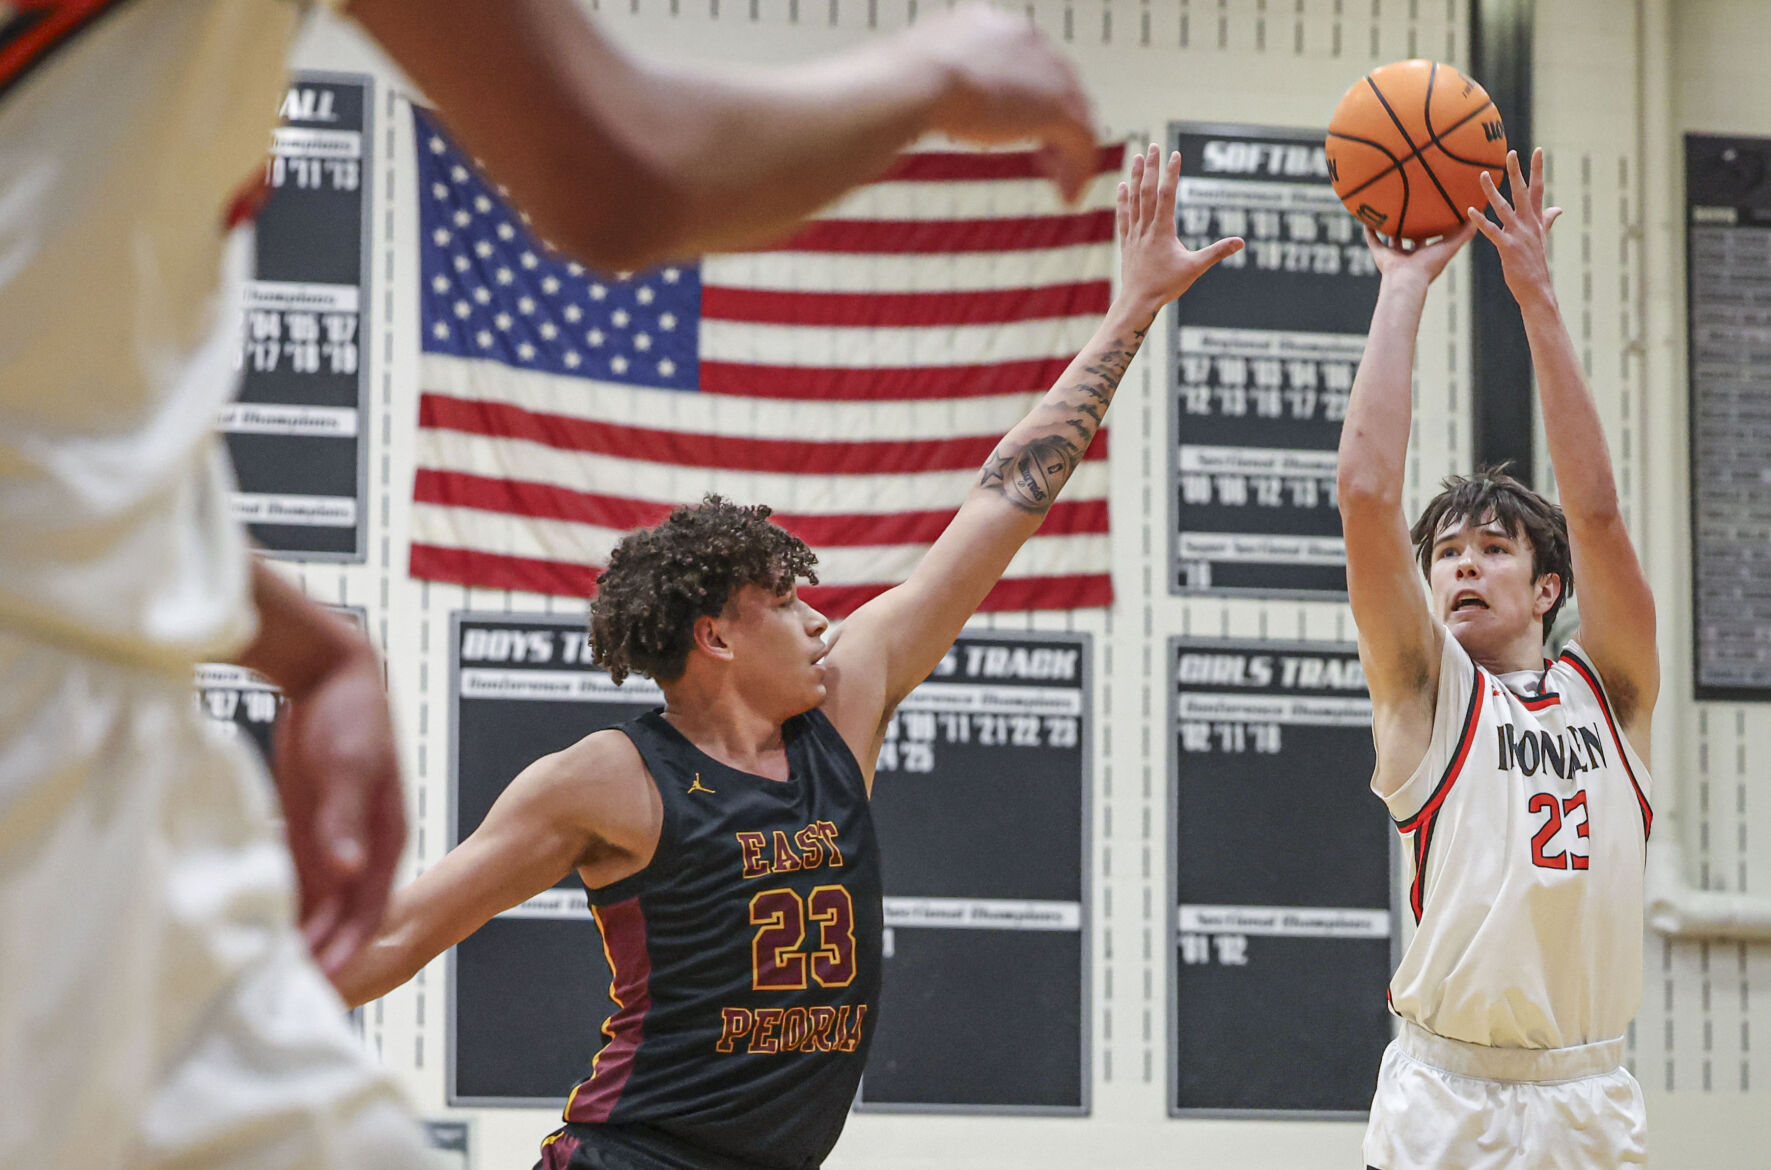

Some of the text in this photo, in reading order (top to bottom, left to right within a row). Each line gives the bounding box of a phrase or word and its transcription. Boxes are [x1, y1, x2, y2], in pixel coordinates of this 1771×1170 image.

[1203, 140, 1326, 176] SOFTBA
[462, 628, 554, 663] BOYS
[963, 645, 1079, 680] TRACK
[1180, 654, 1369, 689] GIRLS TRAC
[1497, 721, 1608, 780] IRONN
[736, 820, 844, 879] EAST
[1528, 789, 1590, 870] 23
[749, 883, 857, 991] 23
[716, 1004, 868, 1054] PEORIA
